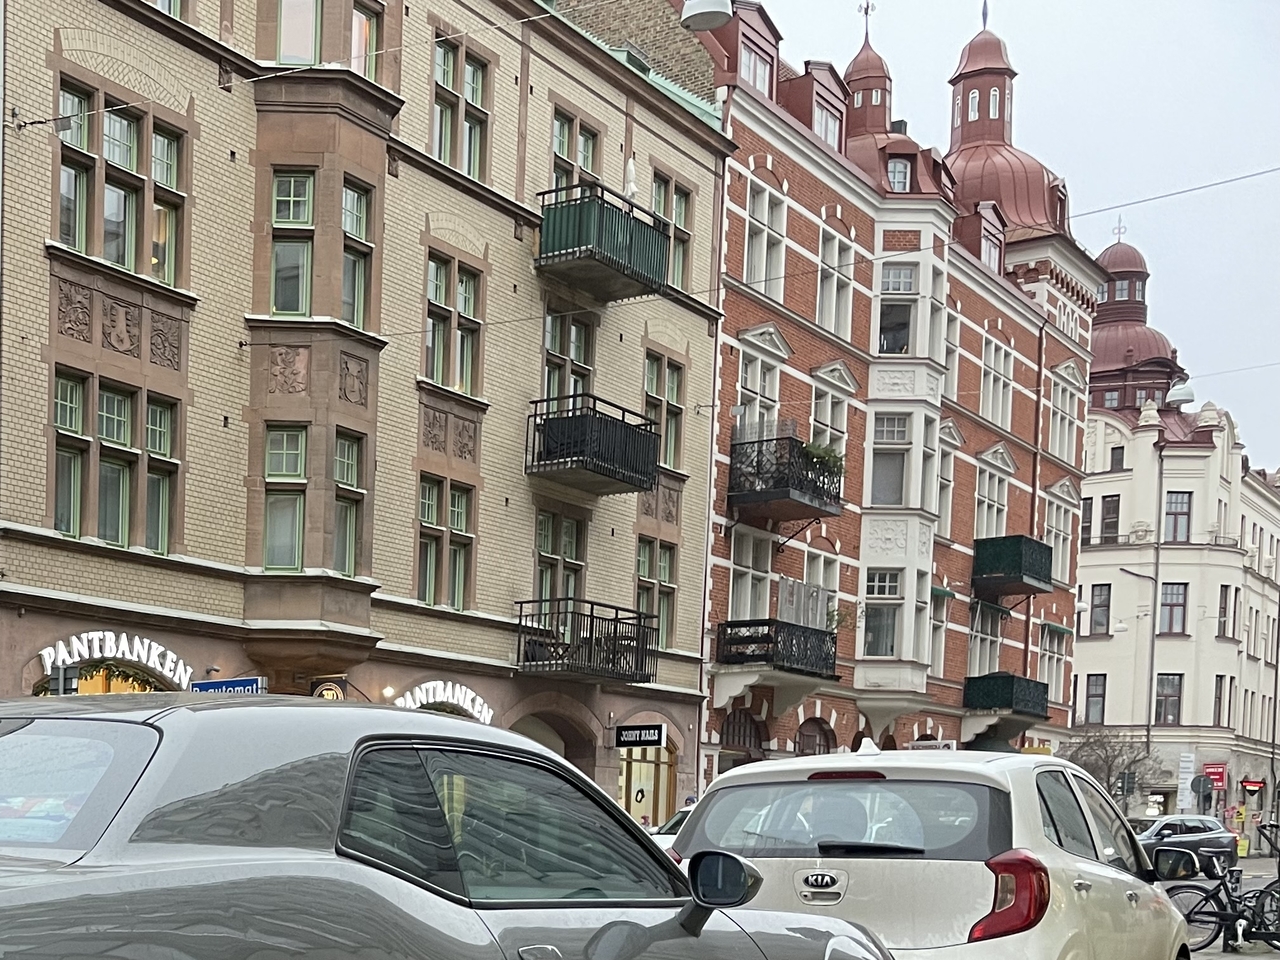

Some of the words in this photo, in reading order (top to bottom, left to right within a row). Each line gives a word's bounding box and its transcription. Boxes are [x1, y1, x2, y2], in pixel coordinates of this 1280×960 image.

[39, 631, 193, 690] PANTBANKEN
[394, 680, 494, 725] PANTBANKEN
[641, 729, 659, 740] NAILS
[808, 875, 832, 886] KIA
